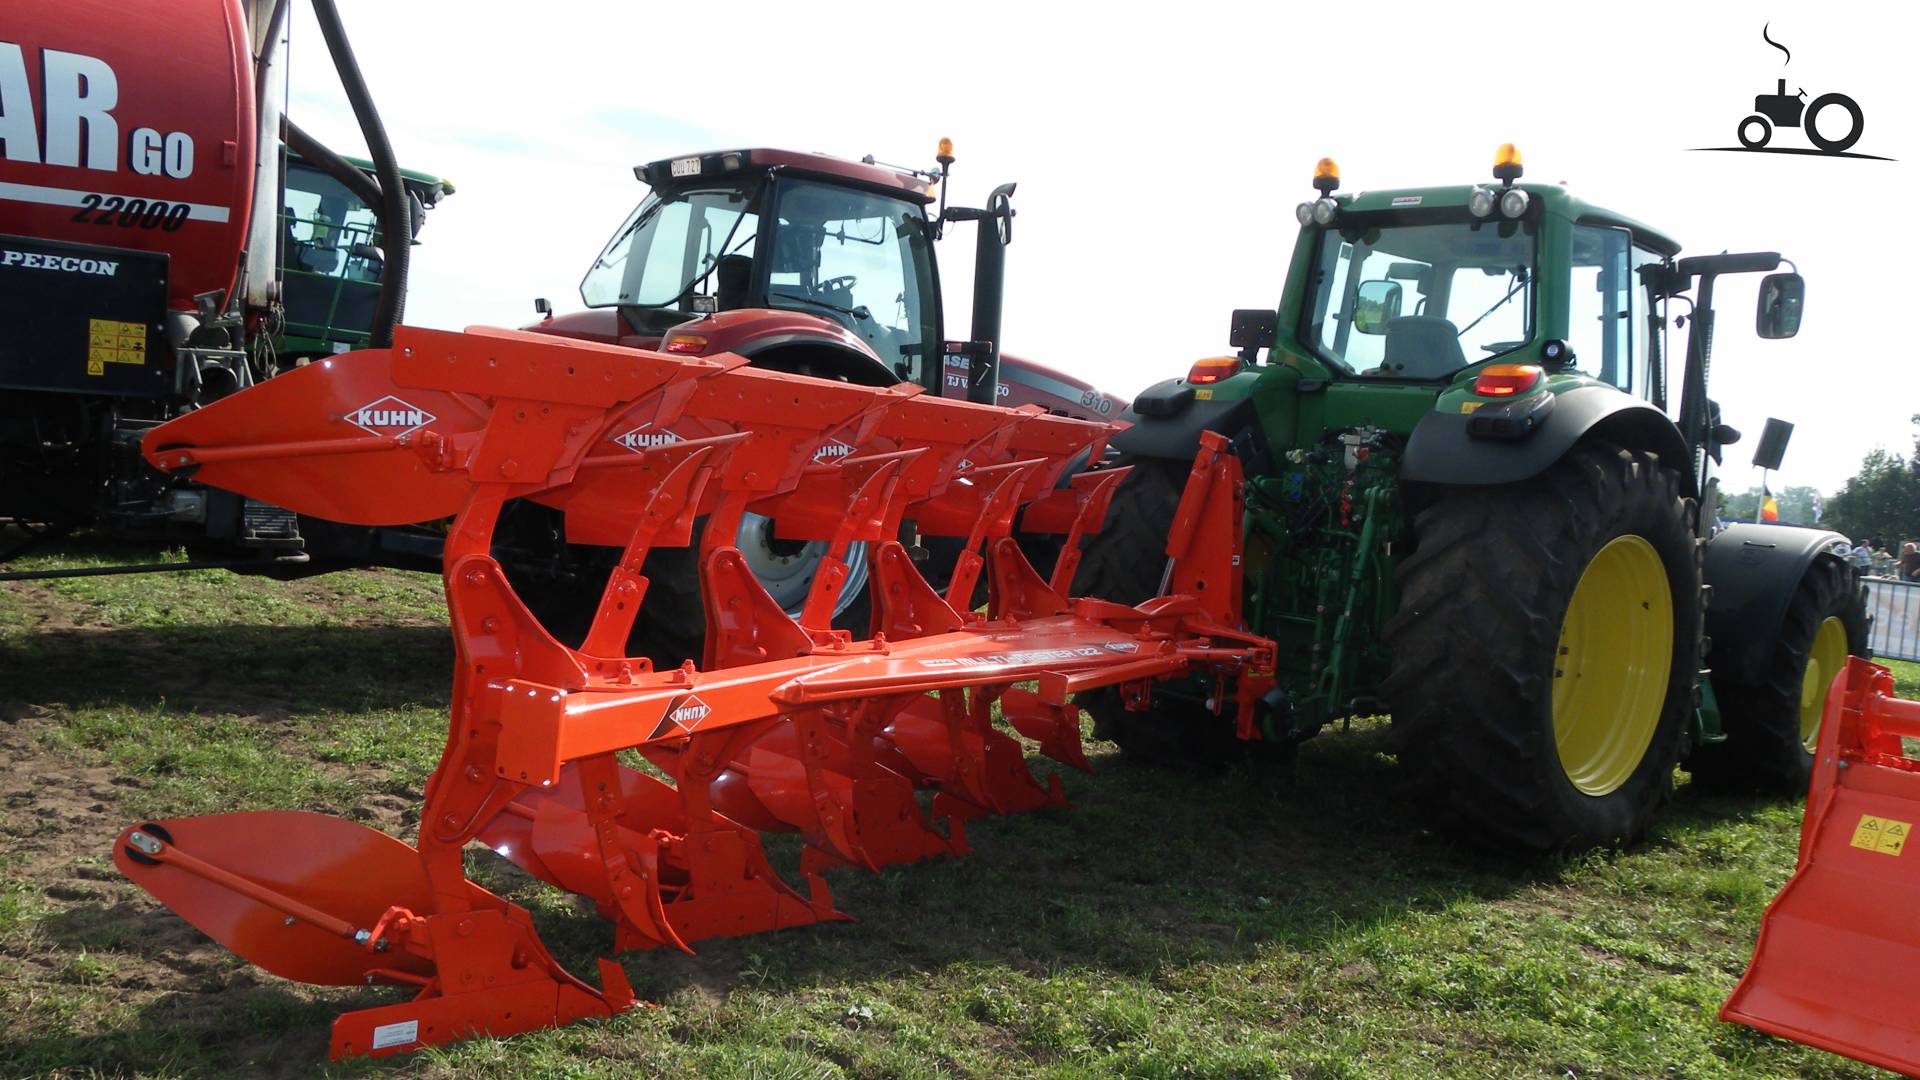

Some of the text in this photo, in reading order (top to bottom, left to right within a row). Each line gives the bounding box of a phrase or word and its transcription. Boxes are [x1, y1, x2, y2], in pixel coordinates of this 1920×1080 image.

[128, 126, 195, 181] GO
[70, 193, 192, 233] 22000
[1, 250, 119, 276] PEECON
[943, 354, 969, 370] ASE
[946, 375, 959, 387] TJ
[1081, 390, 1113, 416] 310
[357, 409, 424, 427] KUHN
[625, 432, 677, 448] KUHN
[814, 445, 849, 457] UHN
[675, 704, 706, 722] KUHN
